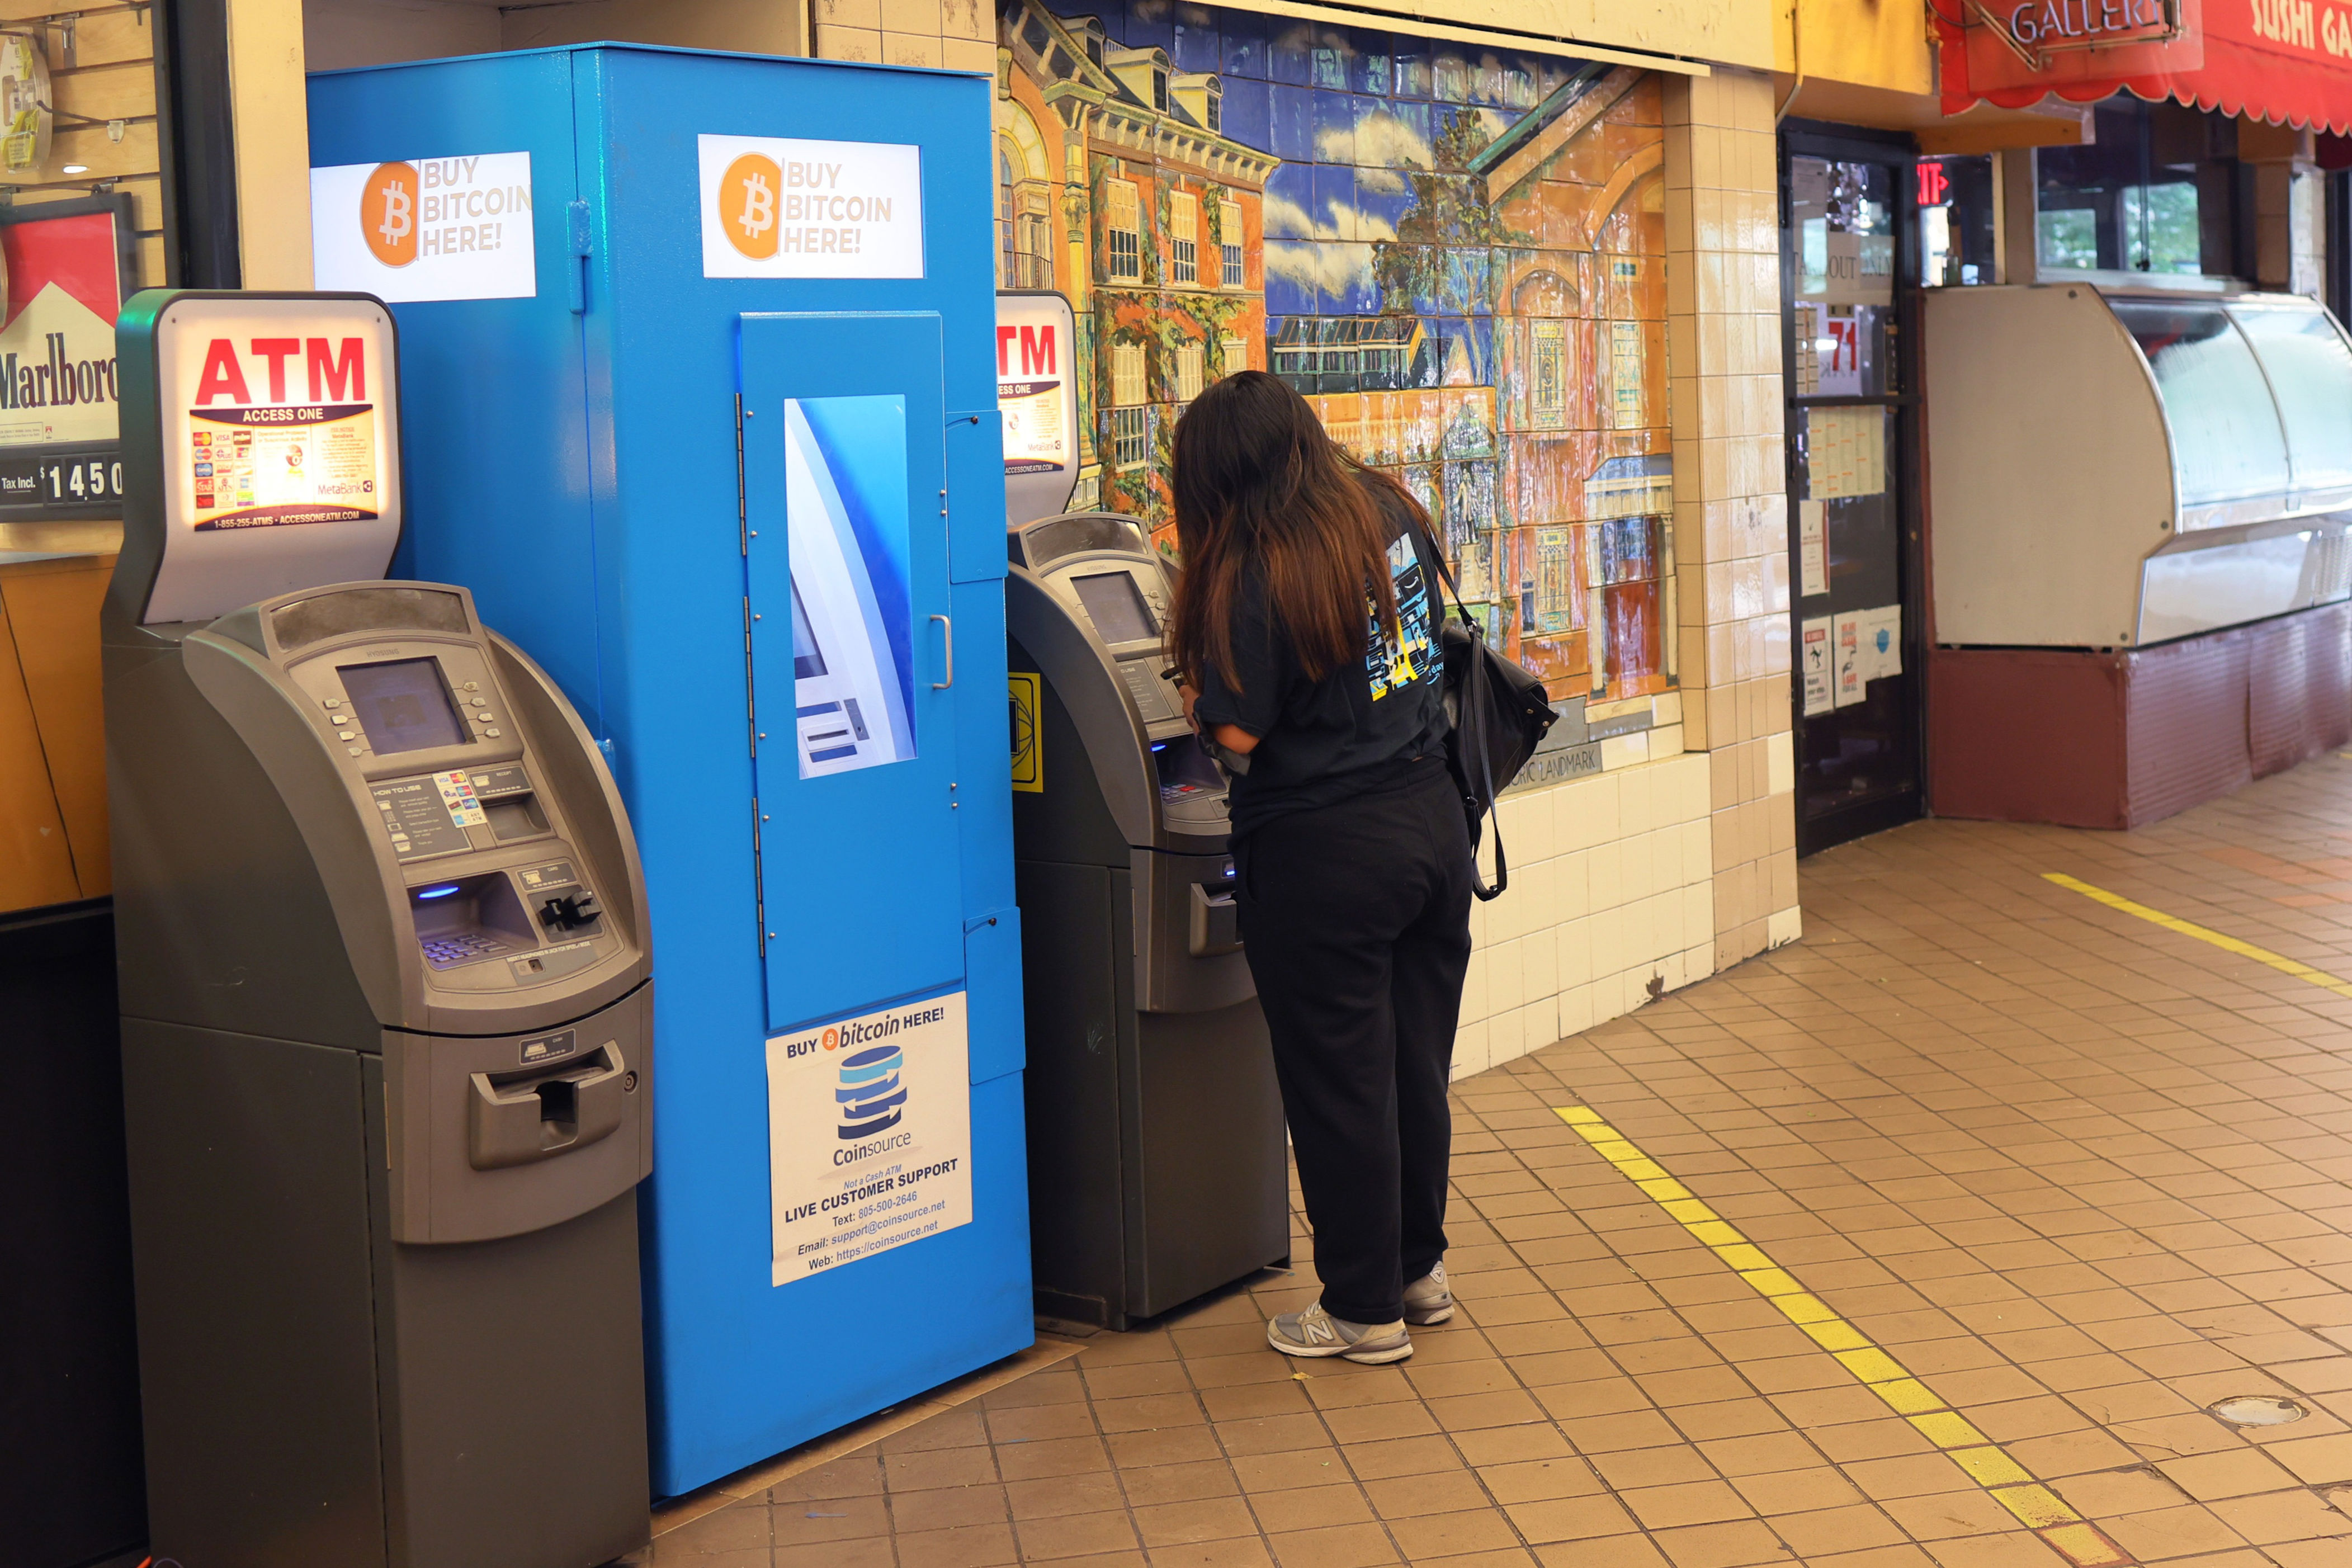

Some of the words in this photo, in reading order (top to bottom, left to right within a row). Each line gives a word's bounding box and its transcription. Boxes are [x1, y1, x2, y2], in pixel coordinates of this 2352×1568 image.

[2250, 0, 2316, 50] SUSHI
[424, 156, 479, 189] BUY
[787, 161, 842, 188] BUY
[423, 184, 532, 223] BITCOIN
[785, 194, 892, 222] BITCOIN
[423, 223, 502, 257] HERE!
[783, 227, 862, 254] HERE!
[1829, 322, 1857, 371] 71
[195, 338, 366, 405] ATM
[1015, 384, 1032, 394] ONE
[243, 409, 294, 422] ACCESS
[297, 408, 324, 420] ONE
[2, 477, 16, 489] Tax
[18, 476, 36, 489] Incl.
[1005, 464, 1054, 474] ACCESSONEATM.COM
[318, 481, 363, 495] MetaBank
[215, 516, 273, 528] 1-855-255-ATMS
[280, 511, 360, 524] ACCESSONEATM.COM
[1540, 750, 1595, 781] LANDMARK
[374, 788, 391, 796] HOW
[787, 1038, 818, 1059] BUY
[839, 1014, 900, 1049] bitcoin
[903, 1007, 944, 1030] HERE!
[833, 1132, 911, 1166] Coinsource
[785, 1202, 817, 1223] LIVE
[820, 1178, 895, 1211] CUSTOMER
[898, 1158, 958, 1187] SUPPORT
[843, 1178, 857, 1190] Not
[859, 1177, 863, 1186] a
[865, 1170, 883, 1183] Cash
[884, 1164, 902, 1178] ATM
[832, 1212, 856, 1227] Text:
[858, 1191, 918, 1219] 805-500-2646
[797, 1238, 829, 1255] Email:
[831, 1199, 946, 1245] support@coinsource.net
[808, 1255, 834, 1271] Web:
[836, 1220, 938, 1262] https://coinsource.net
[1305, 1320, 1334, 1344] N
